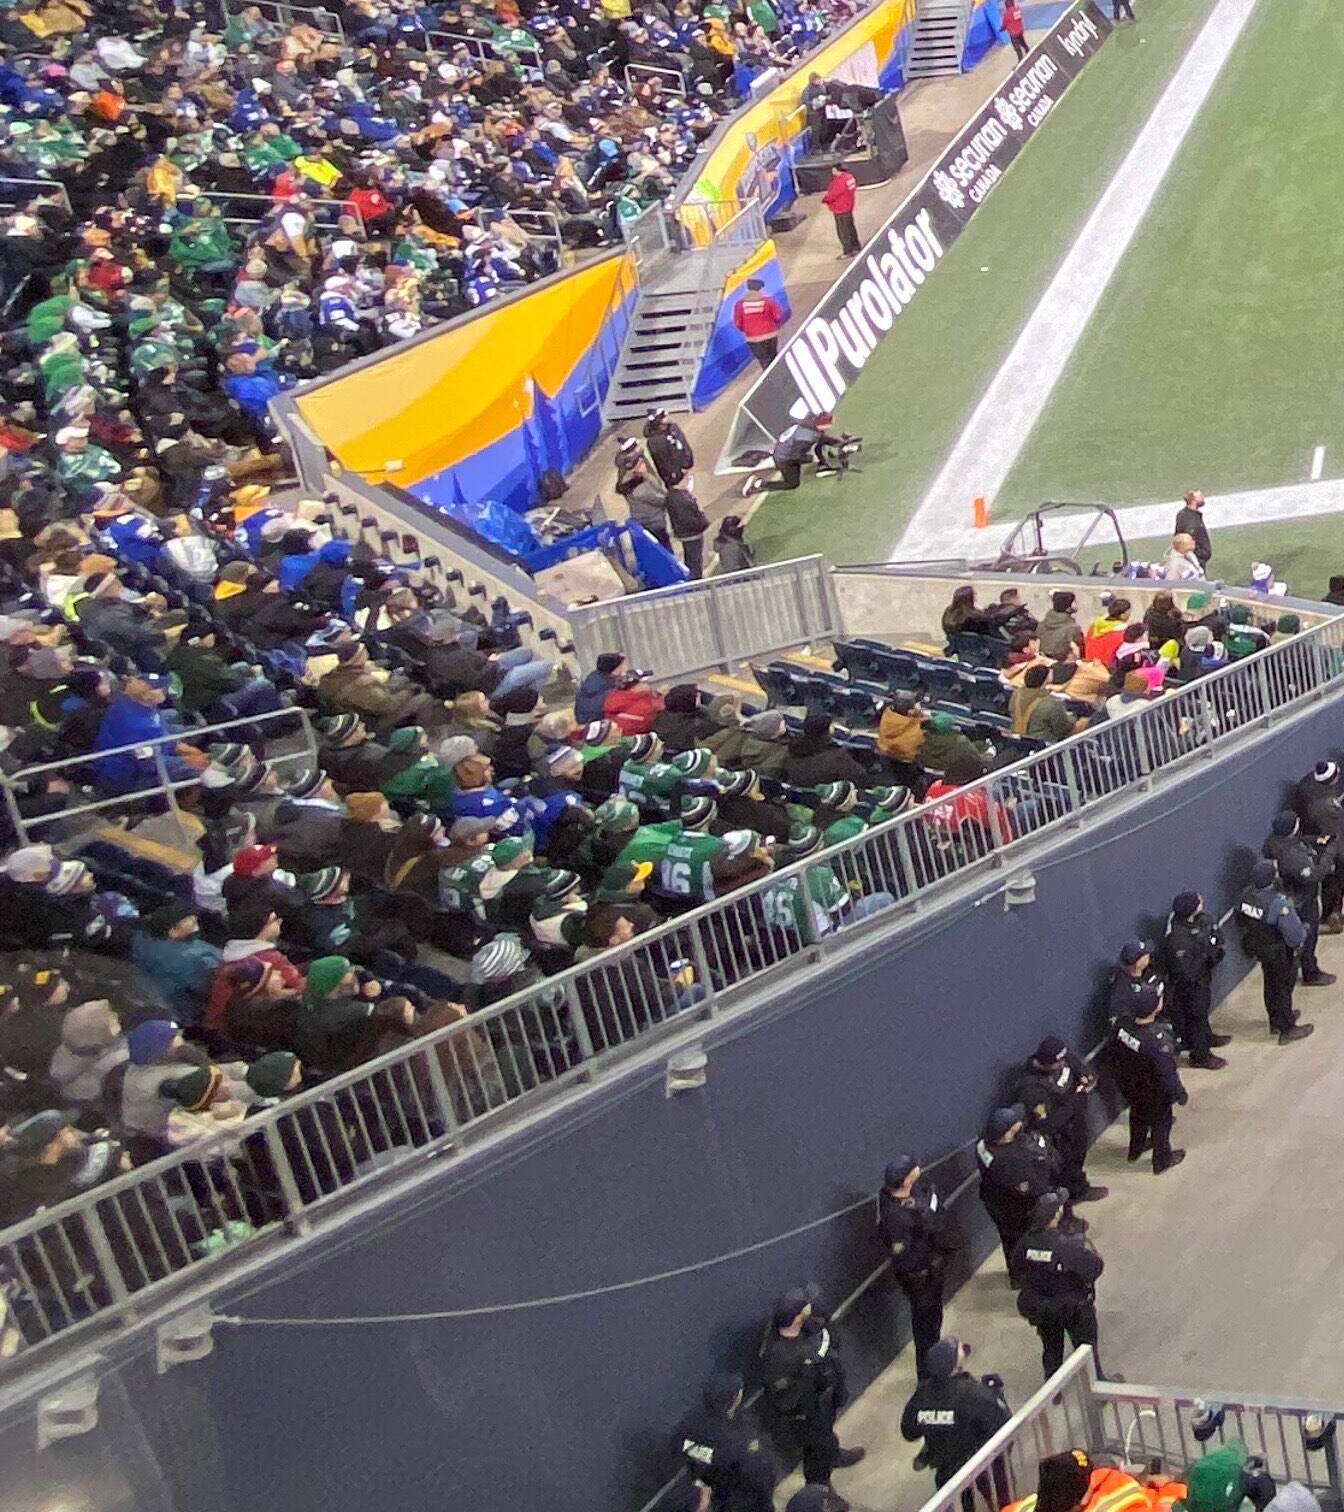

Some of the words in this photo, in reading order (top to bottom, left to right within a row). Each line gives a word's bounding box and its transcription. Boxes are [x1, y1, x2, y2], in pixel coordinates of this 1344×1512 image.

[1056, 10, 1099, 58] kyndryl
[1026, 94, 1054, 127] CANADA
[968, 164, 1002, 203] CANADA
[814, 208, 944, 385] Purolator
[917, 1409, 956, 1426] POLICE
